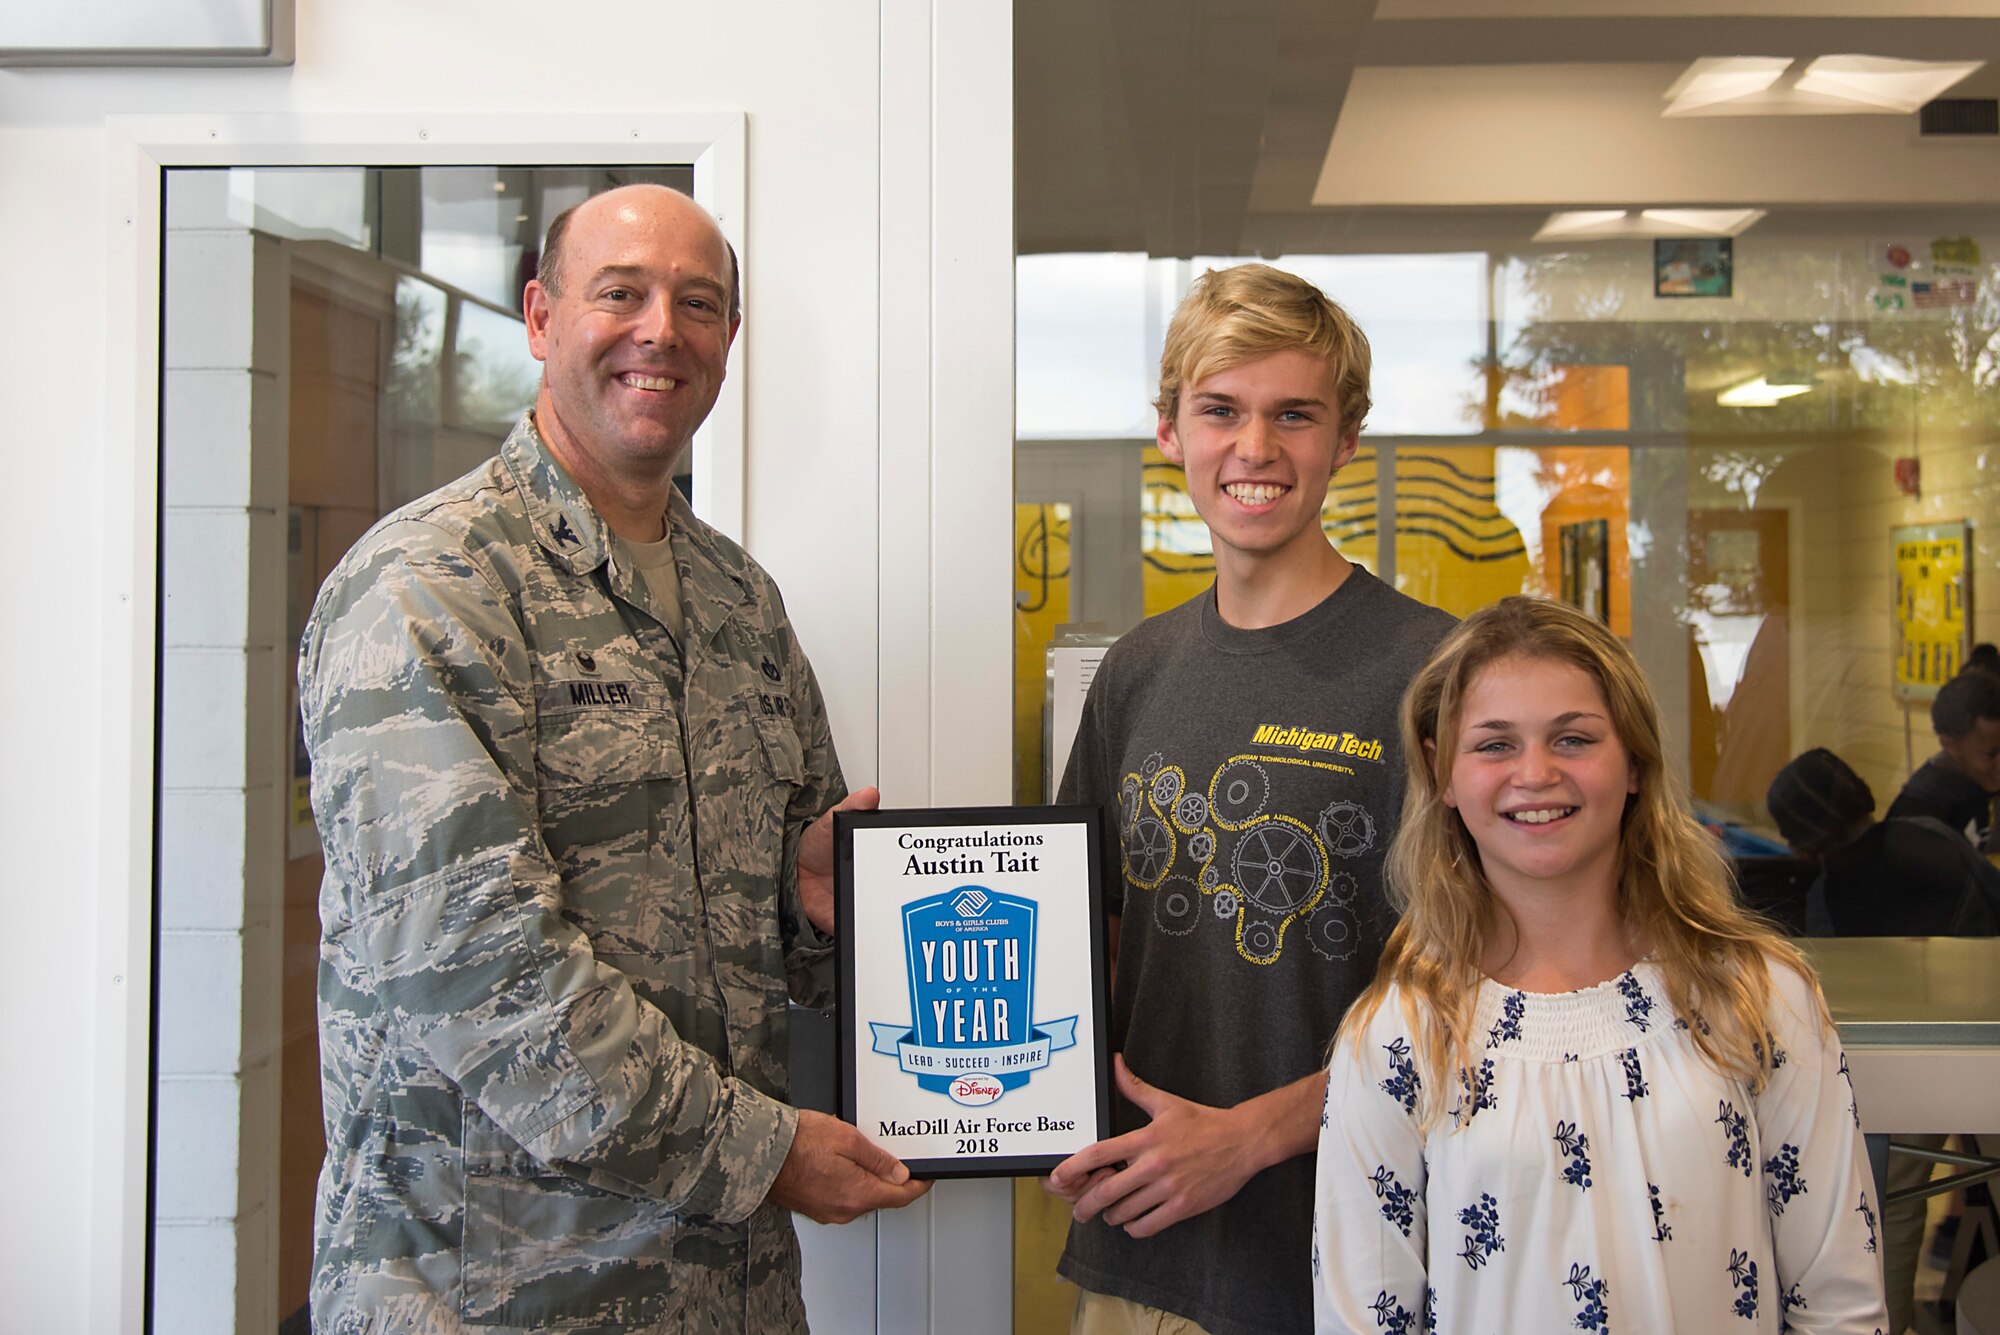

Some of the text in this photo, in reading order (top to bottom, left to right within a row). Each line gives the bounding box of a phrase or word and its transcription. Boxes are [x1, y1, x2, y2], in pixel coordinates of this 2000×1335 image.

[569, 683, 631, 705] MILLER
[1252, 725, 1382, 761] Michigan Tech
[1228, 754, 1258, 764] MICHIGAN
[1259, 755, 1311, 767] TECHNOLOGICAL
[898, 831, 1044, 854] Congratulations
[902, 851, 1040, 876] Austin Tait
[1273, 813, 1330, 916] MICHIGAN TECHNOLOGICAL UNIVERSITY
[1235, 907, 1297, 966] MICHIGAN TECHNOLOGICAL UNIVERSITY
[921, 938, 1019, 983] YOUTH
[932, 998, 1010, 1043] YEAR
[908, 1049, 1042, 1068] LEAD SUCCEED INSPIRE
[879, 1116, 1075, 1136] MacDill Air Force Base
[956, 1139, 999, 1154] 2018
